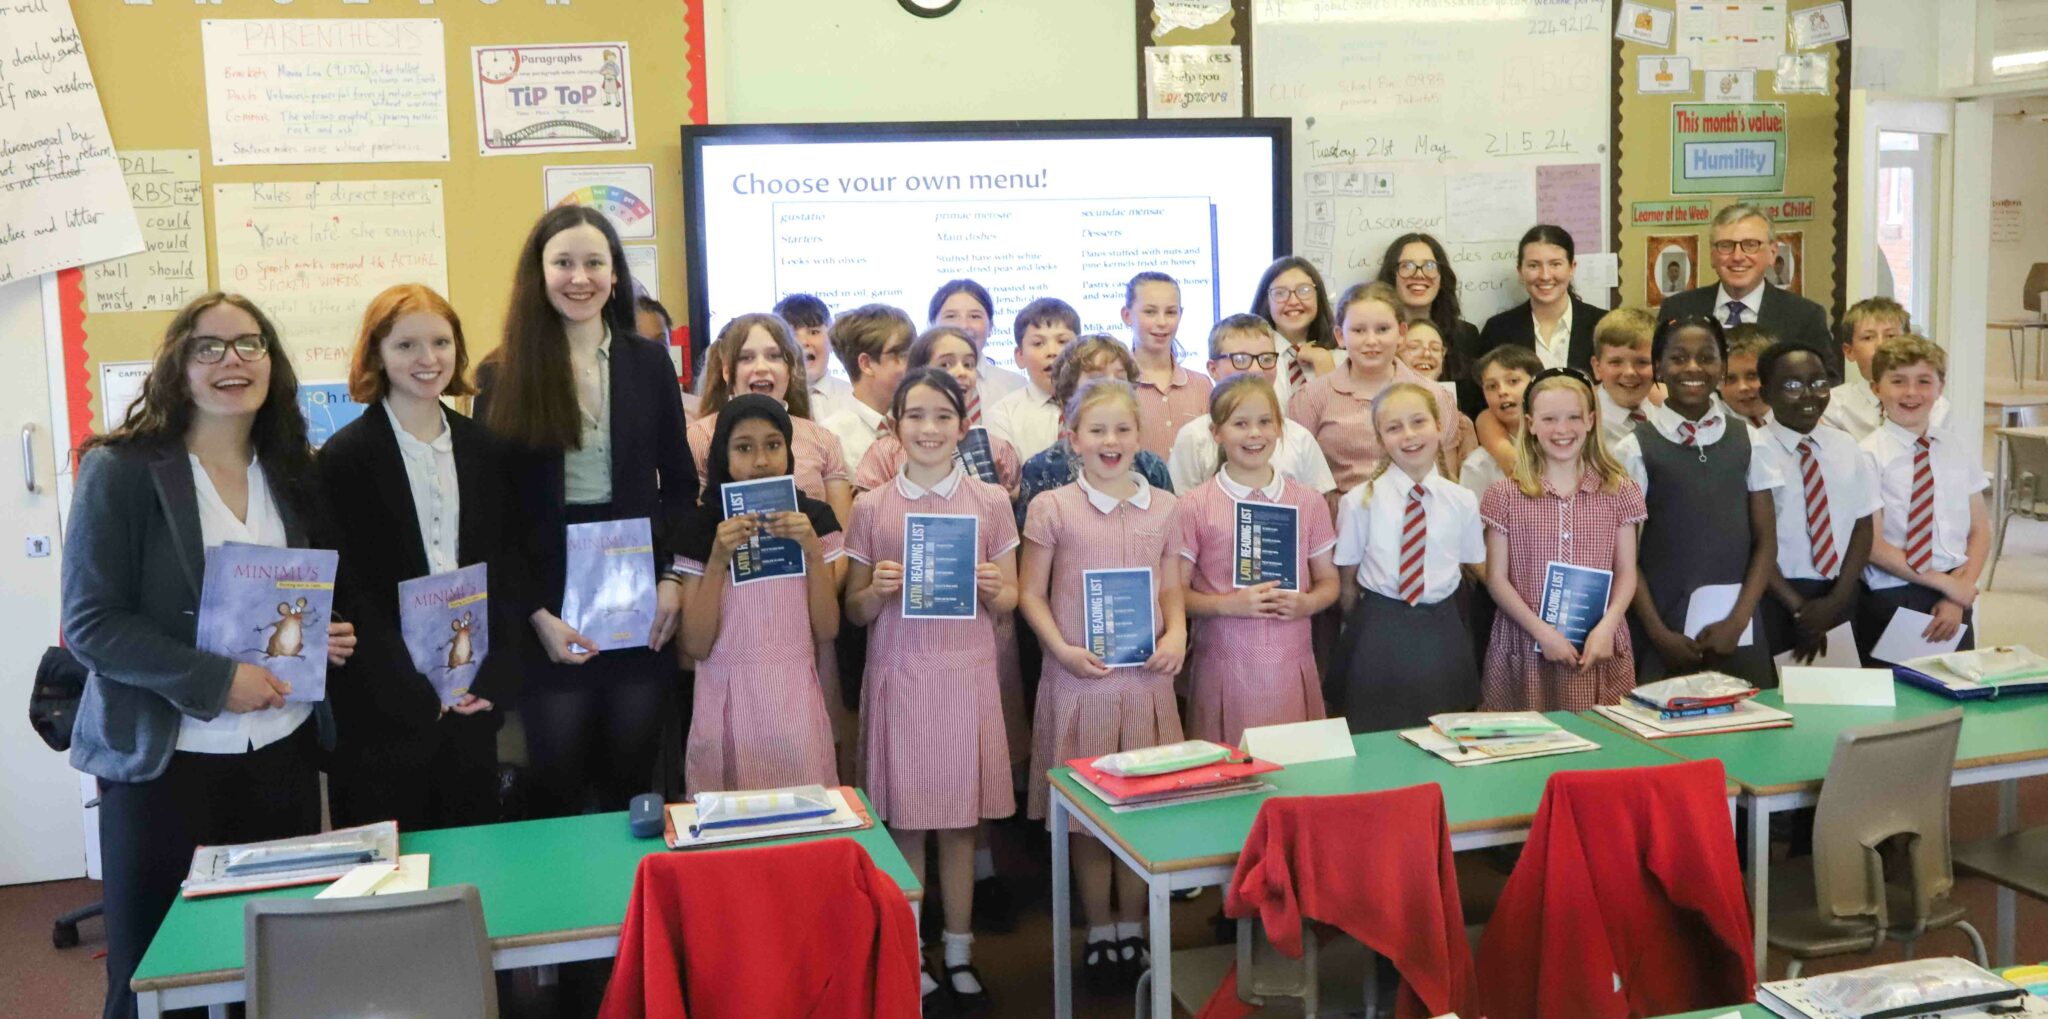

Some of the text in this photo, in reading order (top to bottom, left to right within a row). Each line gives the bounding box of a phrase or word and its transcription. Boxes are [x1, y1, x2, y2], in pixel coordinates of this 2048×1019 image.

[243, 22, 423, 49] PARENTHESIS
[521, 53, 582, 67] Paragraphs
[1198, 72, 1221, 87] you
[508, 85, 597, 107] TiP ToP
[1677, 110, 1700, 133] This
[1703, 110, 1746, 133] month's
[1415, 134, 1450, 164] May
[121, 157, 168, 174] DAL
[1693, 147, 1766, 172] Humility
[732, 168, 1048, 195] Choose your own menu!
[131, 182, 172, 204] RBS
[252, 181, 292, 203] Rules
[1634, 205, 1709, 223] Learner of the Week
[1783, 201, 1812, 218] Child
[146, 211, 191, 229] could
[145, 234, 189, 252] would
[1142, 247, 1162, 256] with
[1184, 246, 1201, 255] and
[1171, 258, 1197, 268] honey
[1452, 247, 1482, 264] des
[94, 260, 194, 280] shall should
[1082, 280, 1110, 290] Pastry
[1183, 276, 1209, 287] honey
[147, 287, 189, 305] might
[1082, 291, 1100, 300] and
[1083, 322, 1123, 333] Milk and
[118, 370, 147, 379] CAPITA
[730, 491, 743, 514] LIST
[1240, 507, 1253, 581] LIST READING LATIN
[737, 555, 751, 577] LATIN
[909, 522, 925, 610] LIST READING LATIN
[1090, 578, 1103, 596] LIST
[1546, 570, 1565, 624] LIST READING
[1092, 597, 1105, 634] READING
